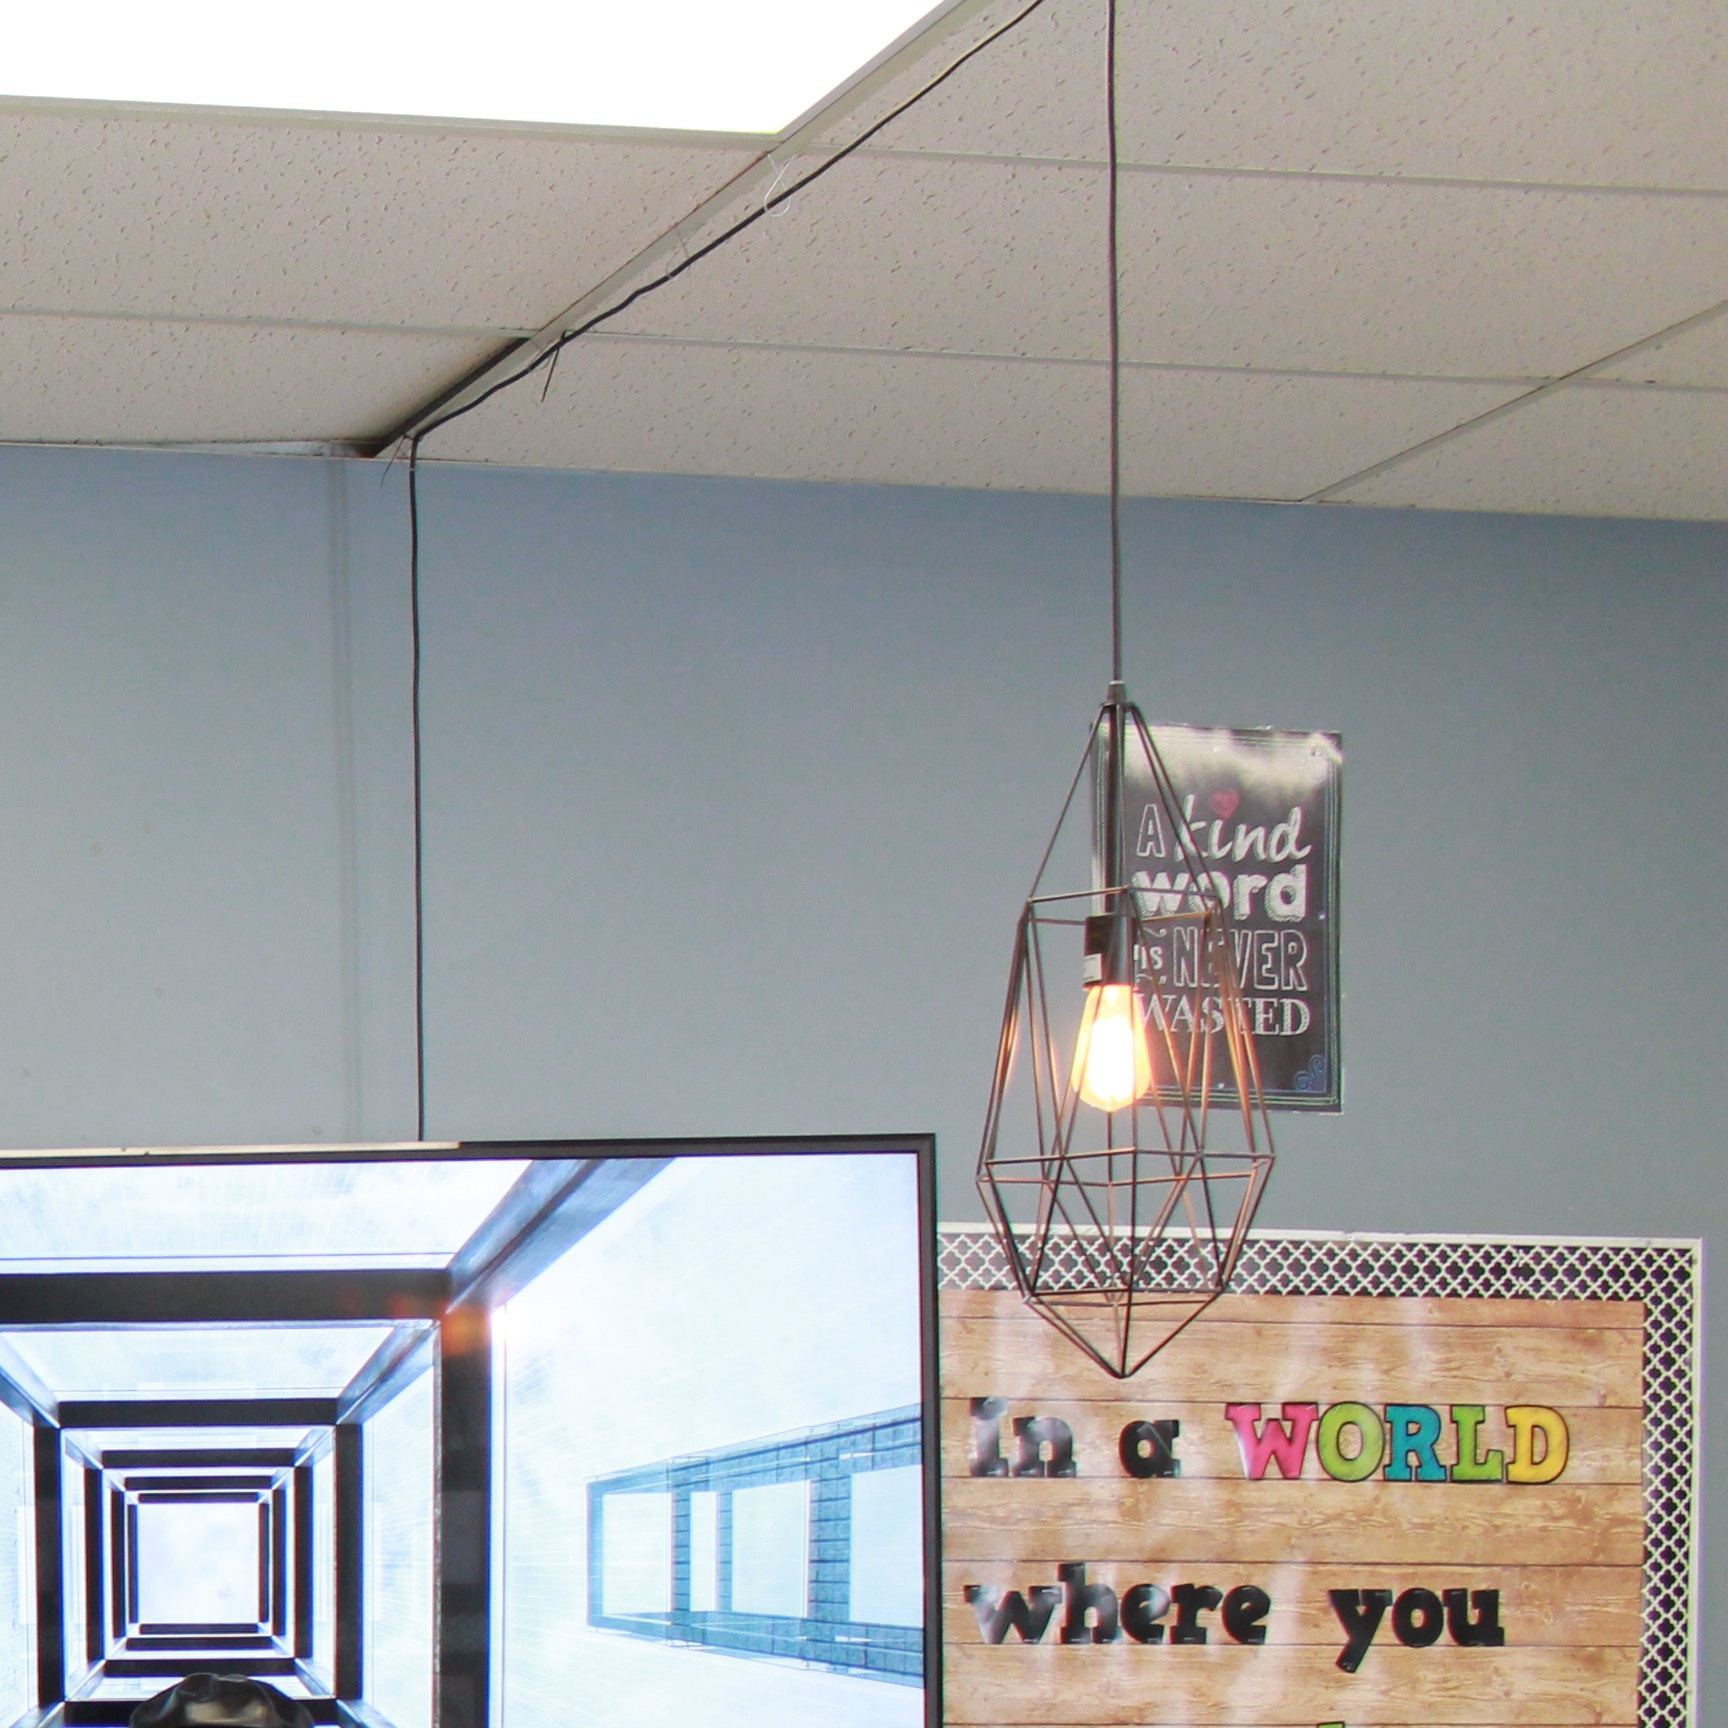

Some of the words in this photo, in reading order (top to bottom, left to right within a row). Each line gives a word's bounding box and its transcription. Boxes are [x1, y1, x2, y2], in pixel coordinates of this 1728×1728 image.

[1136, 803, 1165, 857] A
[1174, 793, 1311, 864] kind
[1131, 863, 1309, 923] word
[1172, 926, 1308, 992] NEVER
[1138, 996, 1311, 1037] WASTED
[1117, 1418, 1181, 1480] a
[1224, 1400, 1570, 1484] WORLD
[962, 1562, 1272, 1647] where
[1328, 1585, 1505, 1674] you
